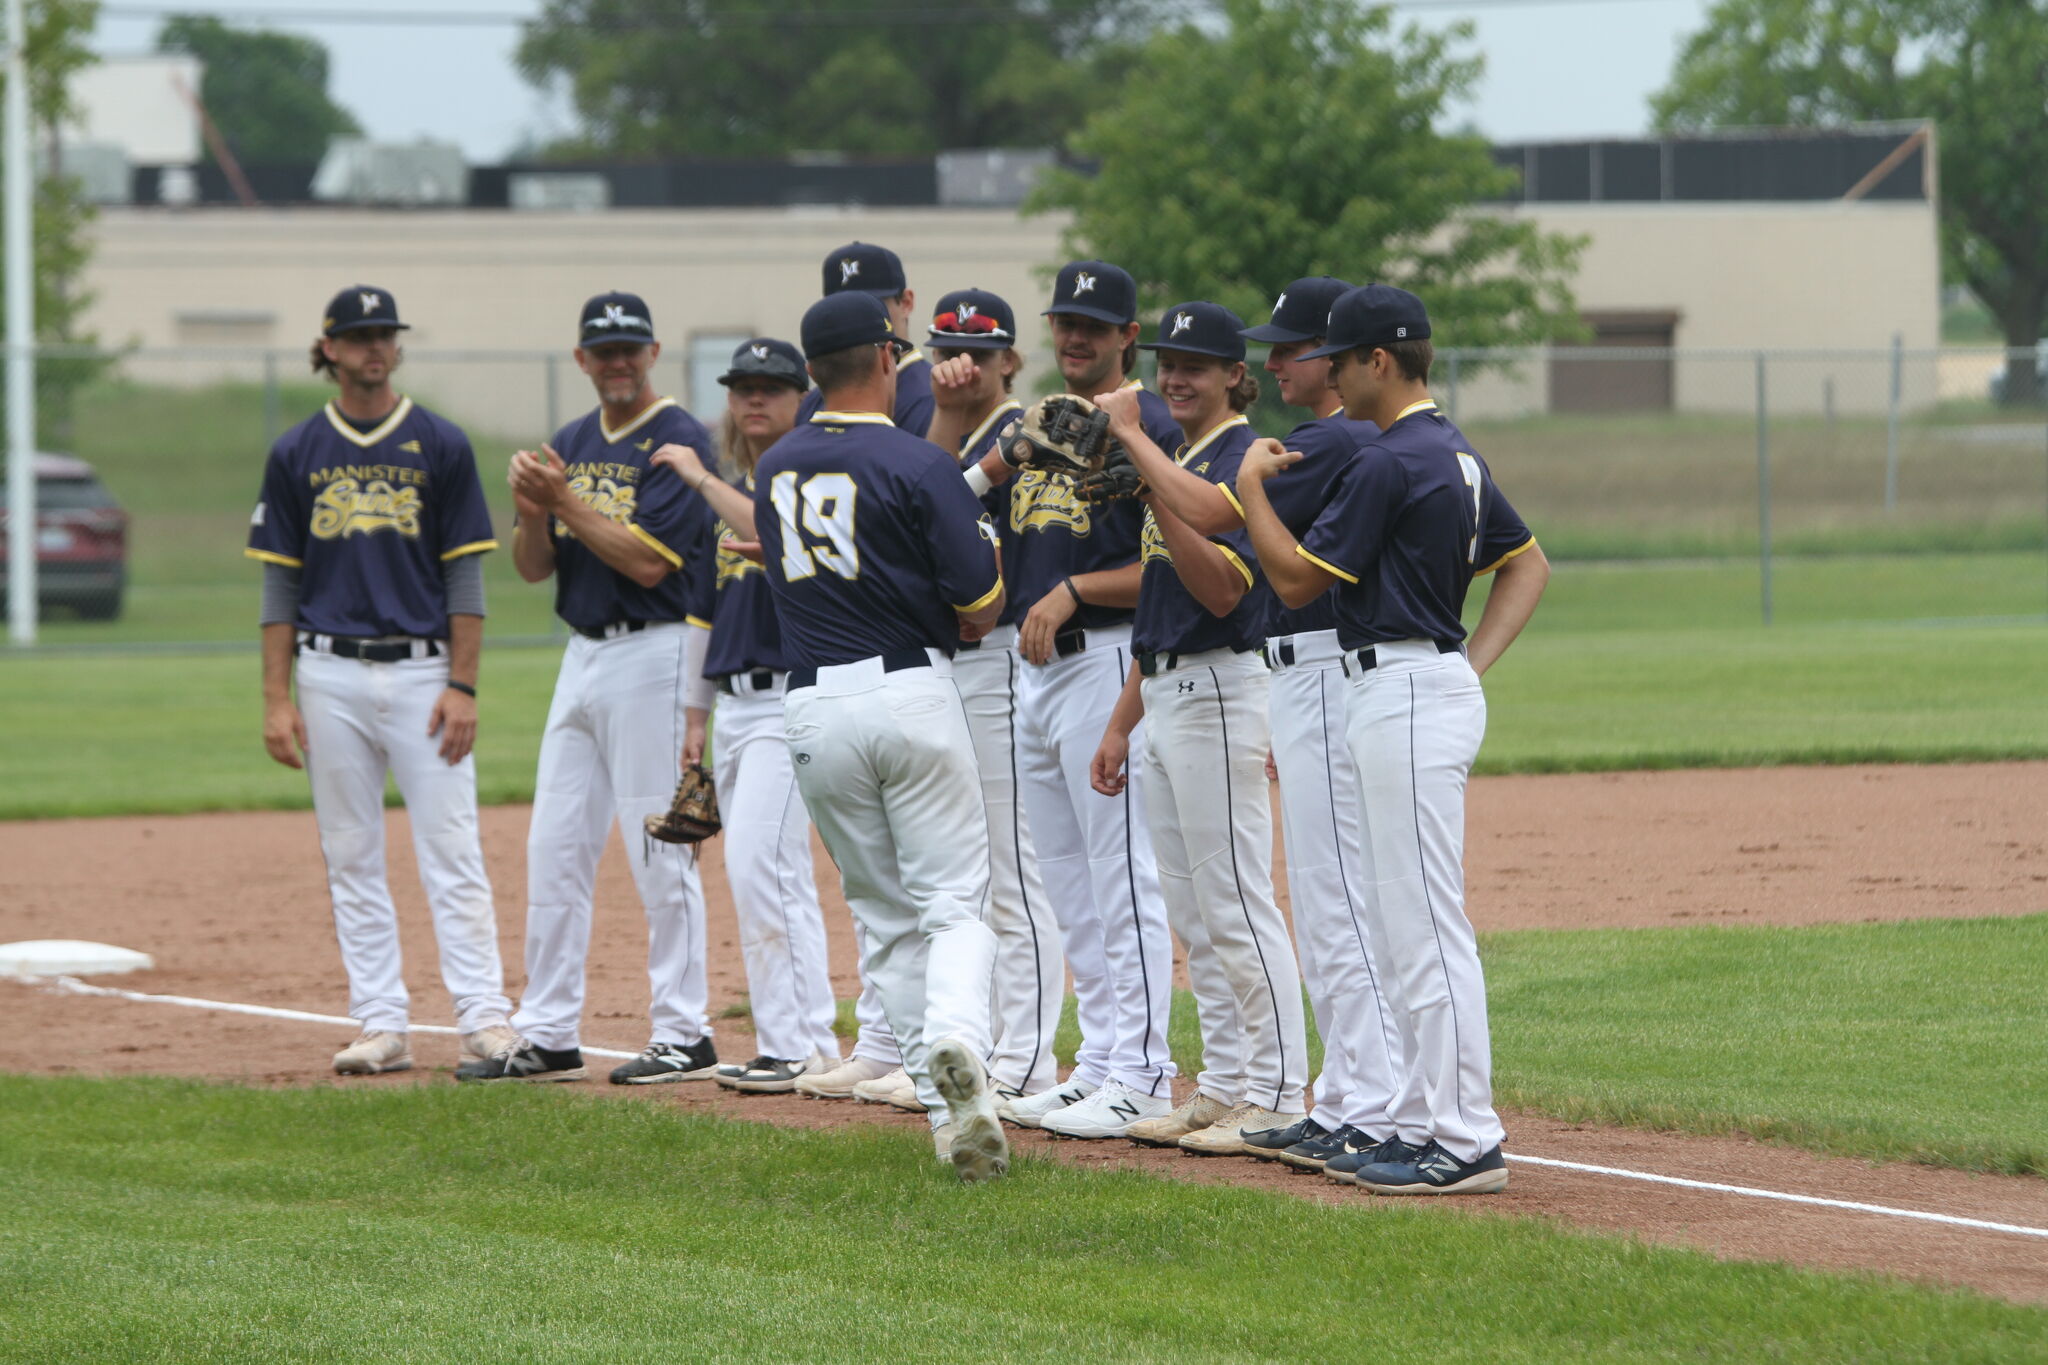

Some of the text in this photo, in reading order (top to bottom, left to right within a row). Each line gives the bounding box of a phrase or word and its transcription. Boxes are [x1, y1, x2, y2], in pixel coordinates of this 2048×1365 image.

[1073, 272, 1096, 298] M
[1170, 312, 1193, 338] M
[309, 464, 427, 487] MANISTEE
[770, 470, 859, 582] 19
